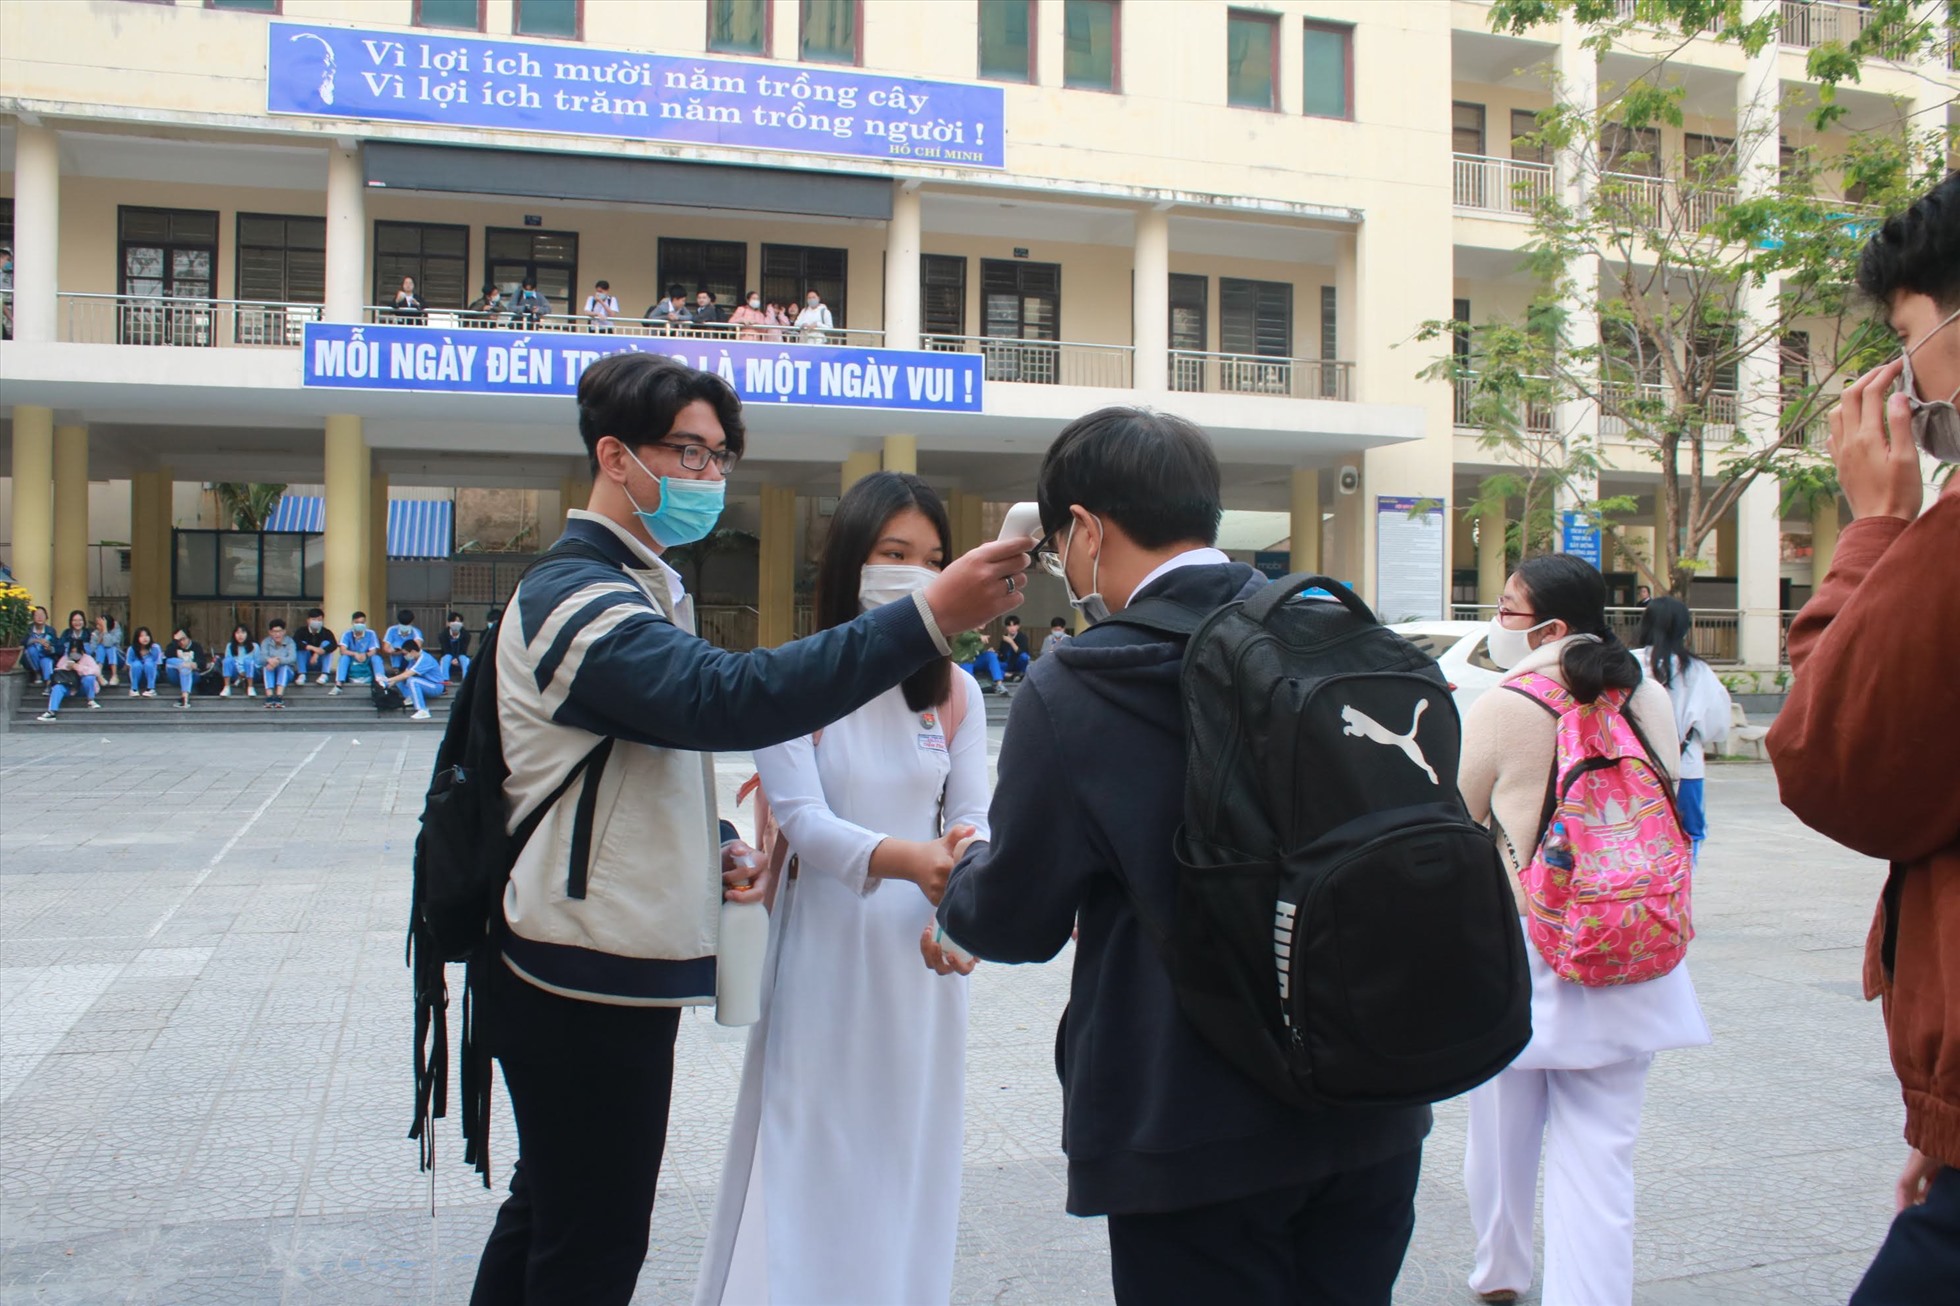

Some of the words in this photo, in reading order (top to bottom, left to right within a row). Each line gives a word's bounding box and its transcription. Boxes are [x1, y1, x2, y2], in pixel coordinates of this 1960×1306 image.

[361, 39, 406, 67] Vì
[419, 44, 469, 77] lợi
[482, 49, 543, 77] ích
[554, 59, 653, 86] mười
[664, 67, 746, 93] năm
[756, 71, 858, 109] trồng
[867, 85, 929, 115] cây
[361, 71, 405, 98] Vì
[418, 76, 468, 109] lợi
[482, 81, 542, 108] ích
[553, 89, 649, 117] trăm
[660, 97, 742, 124] năm
[751, 101, 855, 138] trồng
[864, 118, 965, 143] người
[975, 122, 985, 146] !
[914, 145, 941, 158] CHÍ
[944, 148, 983, 162] MINH
[314, 327, 379, 378] MỖI
[390, 336, 478, 382] NGÀY
[486, 336, 553, 385] ĐẾN
[744, 352, 812, 402] MỘT
[820, 356, 899, 399] NGÀY
[906, 366, 954, 402] VUI
[963, 369, 973, 403] !
